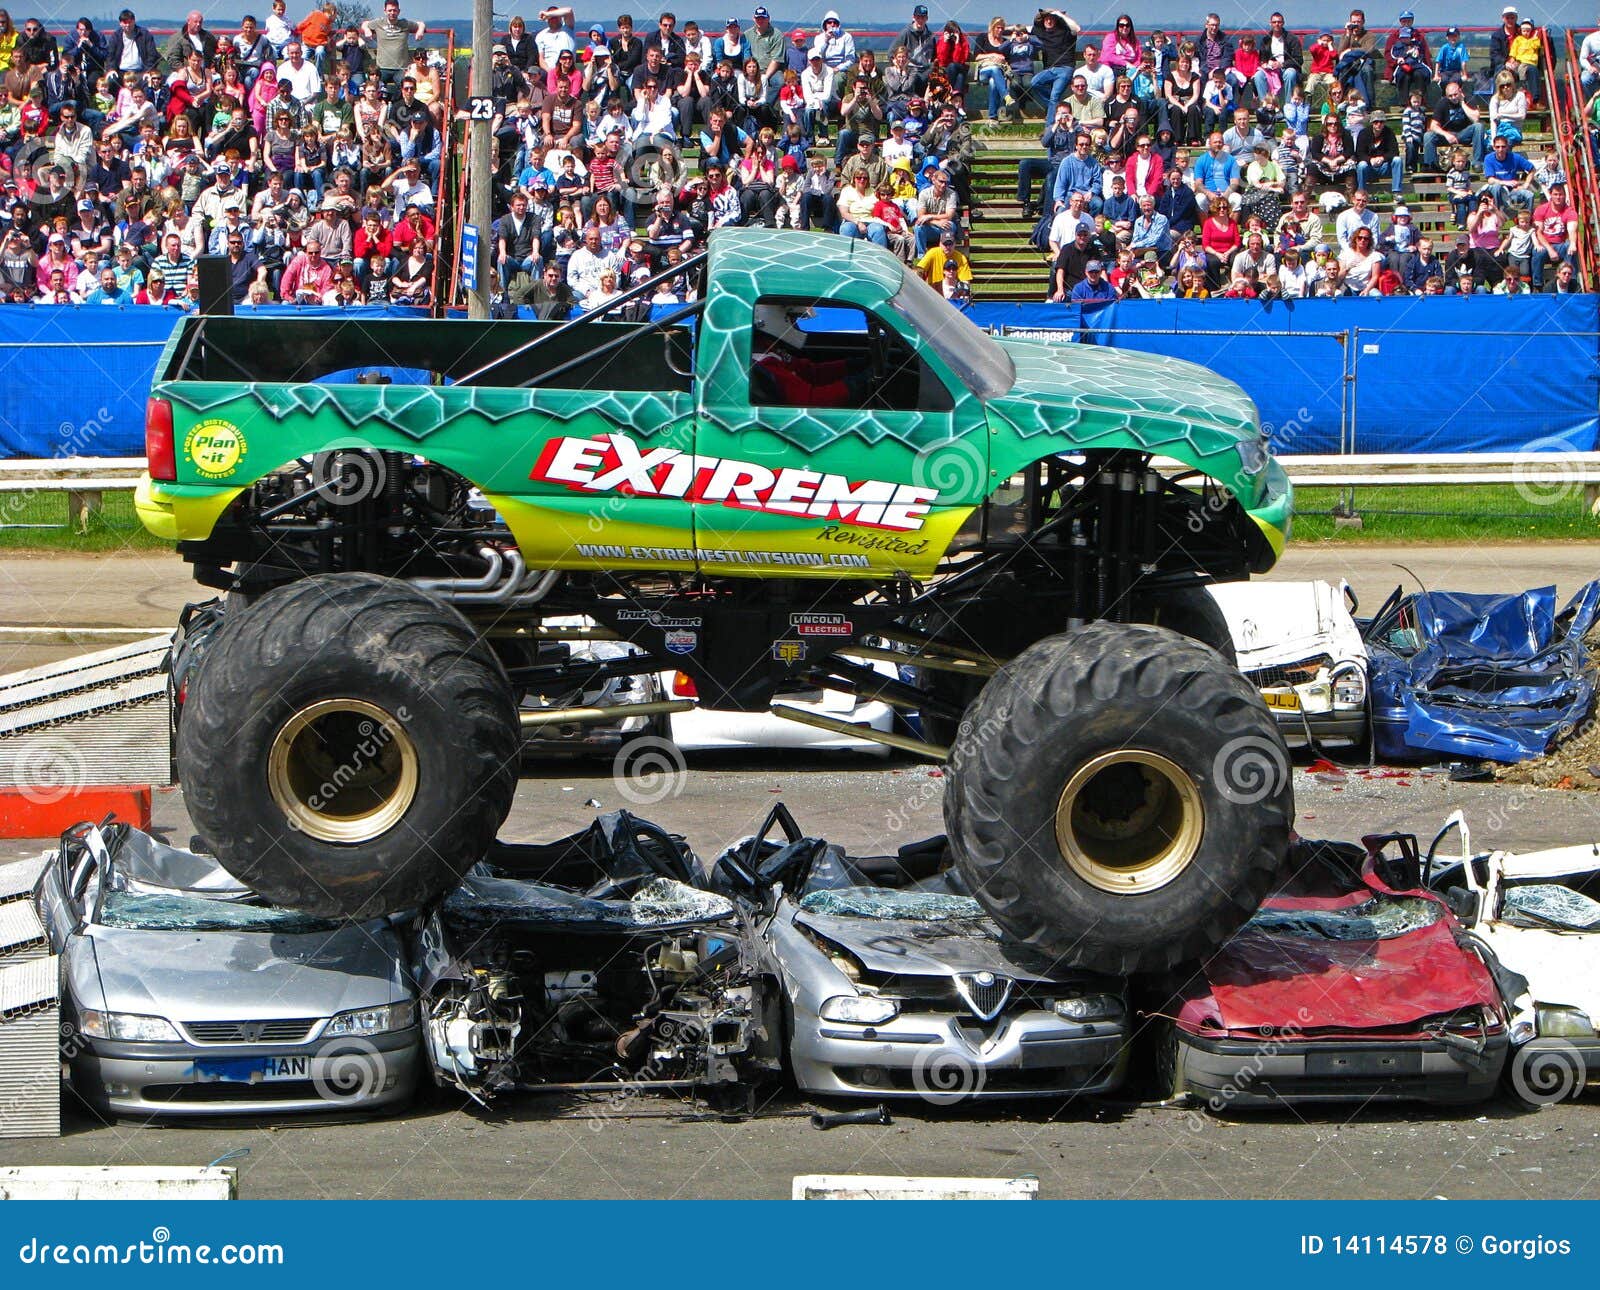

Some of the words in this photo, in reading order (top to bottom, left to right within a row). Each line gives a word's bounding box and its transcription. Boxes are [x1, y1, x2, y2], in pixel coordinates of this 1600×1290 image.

[471, 99, 493, 119] 23
[195, 436, 236, 449] Plan
[530, 433, 940, 531] EXTREME
[816, 525, 929, 556] Revisited
[576, 543, 870, 568] WWW.EXTREMESTUNTSHOW.COM
[793, 615, 841, 625] LINCOLN
[804, 625, 848, 634] ELECTRIC
